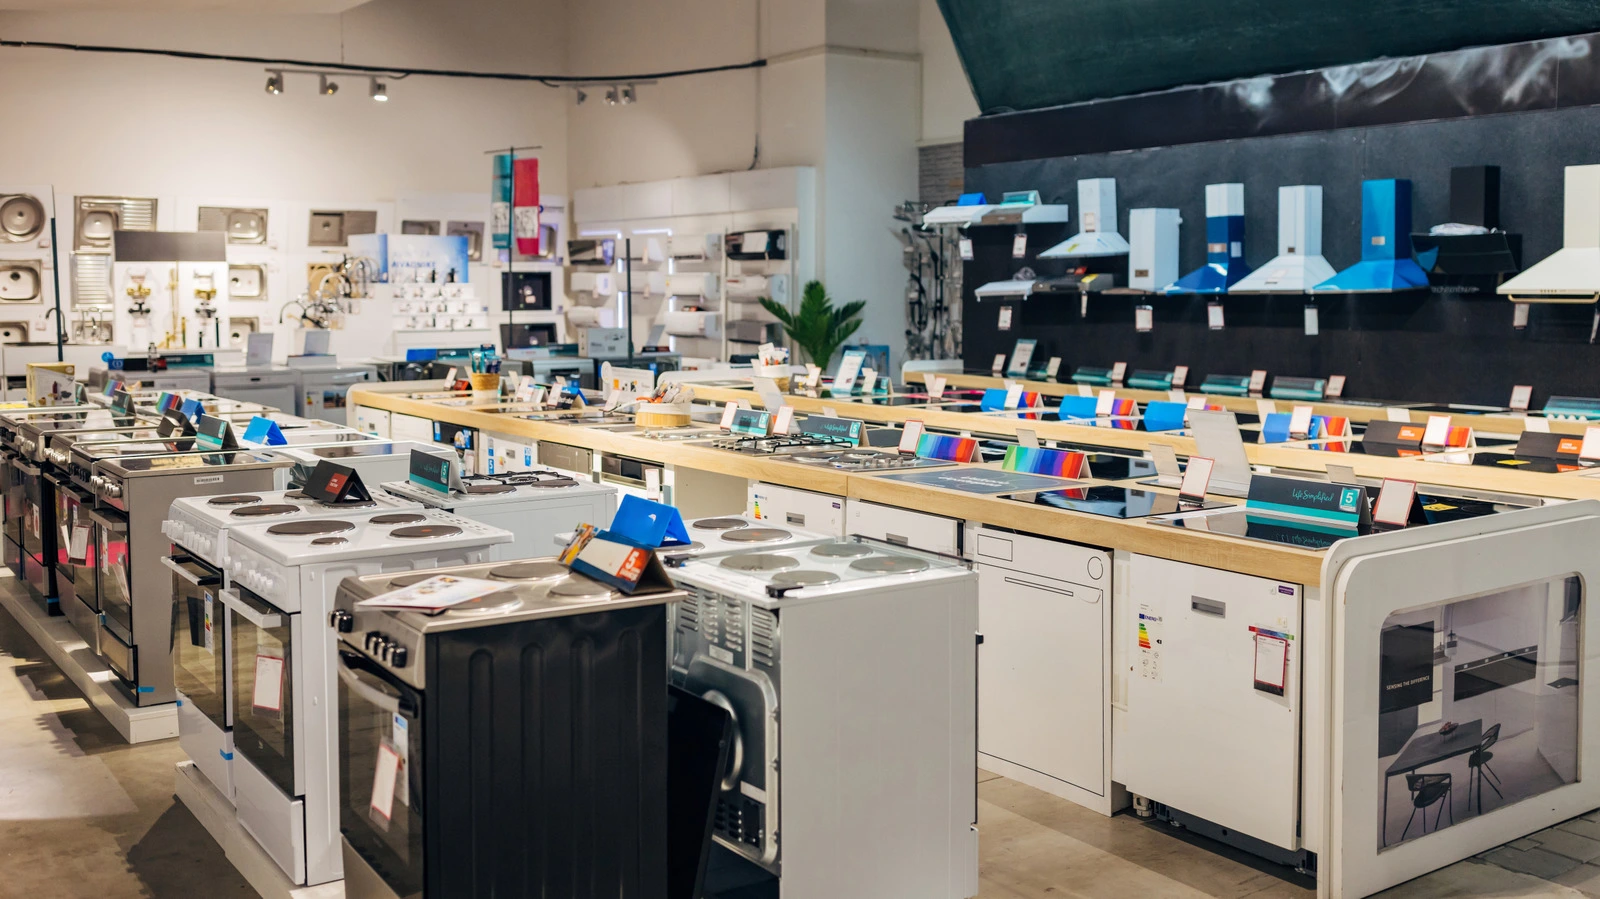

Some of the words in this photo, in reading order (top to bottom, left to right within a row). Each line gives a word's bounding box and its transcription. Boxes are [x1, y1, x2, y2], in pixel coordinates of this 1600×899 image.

[1303, 489, 1335, 503] Simplified
[1345, 492, 1354, 504] 5
[625, 550, 640, 569] 5
[1386, 682, 1403, 691] SENSING
[1410, 675, 1430, 685] DIFFERENCE
